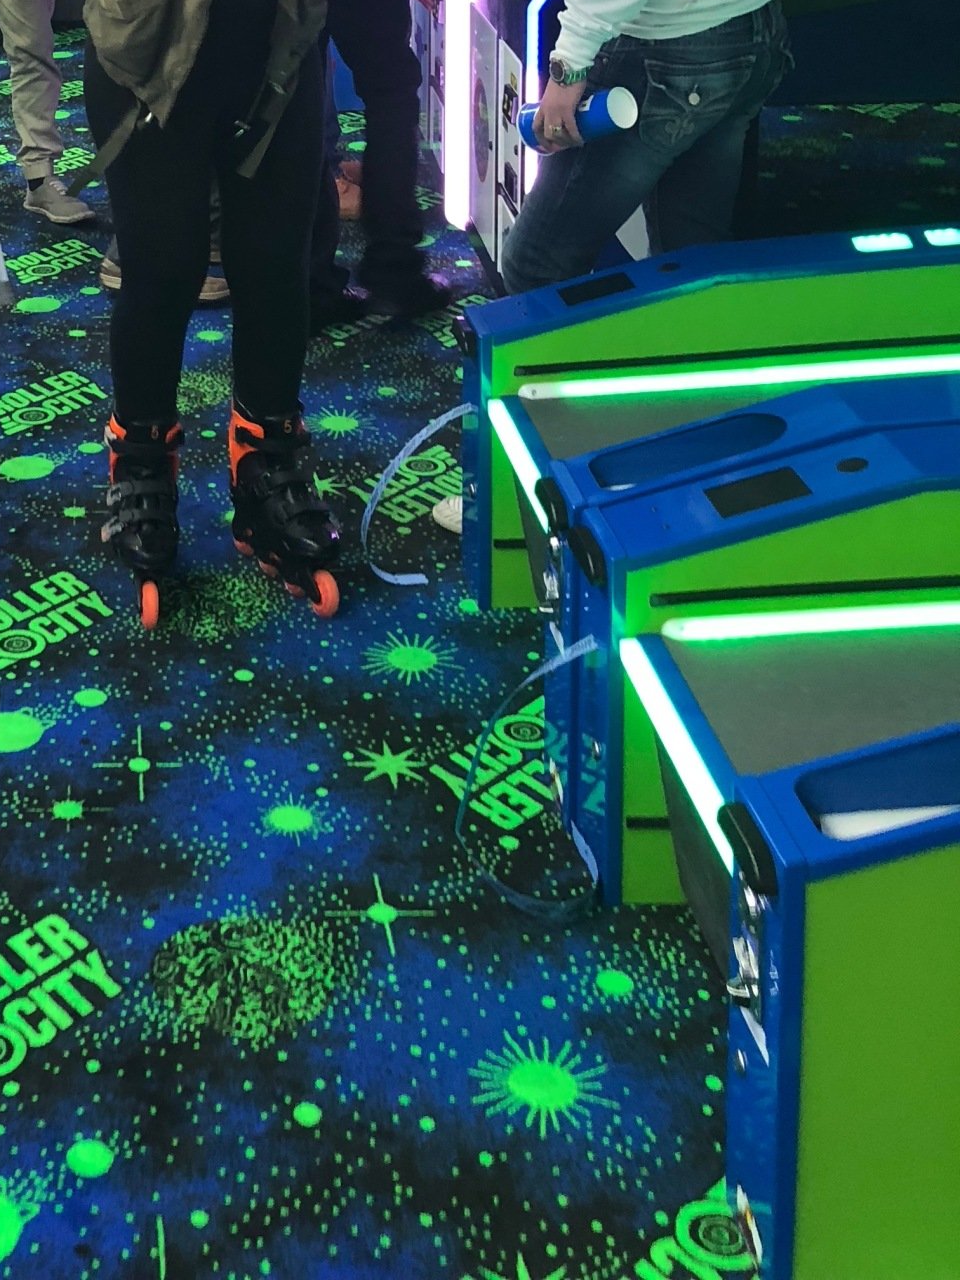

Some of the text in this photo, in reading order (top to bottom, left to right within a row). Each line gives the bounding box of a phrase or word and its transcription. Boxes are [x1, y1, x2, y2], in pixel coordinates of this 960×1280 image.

[4, 238, 90, 271] ROLLER
[49, 247, 105, 271] CITY
[41, 382, 109, 417] CITY
[28, 590, 114, 644] CITY
[2, 949, 123, 1048] CITY
